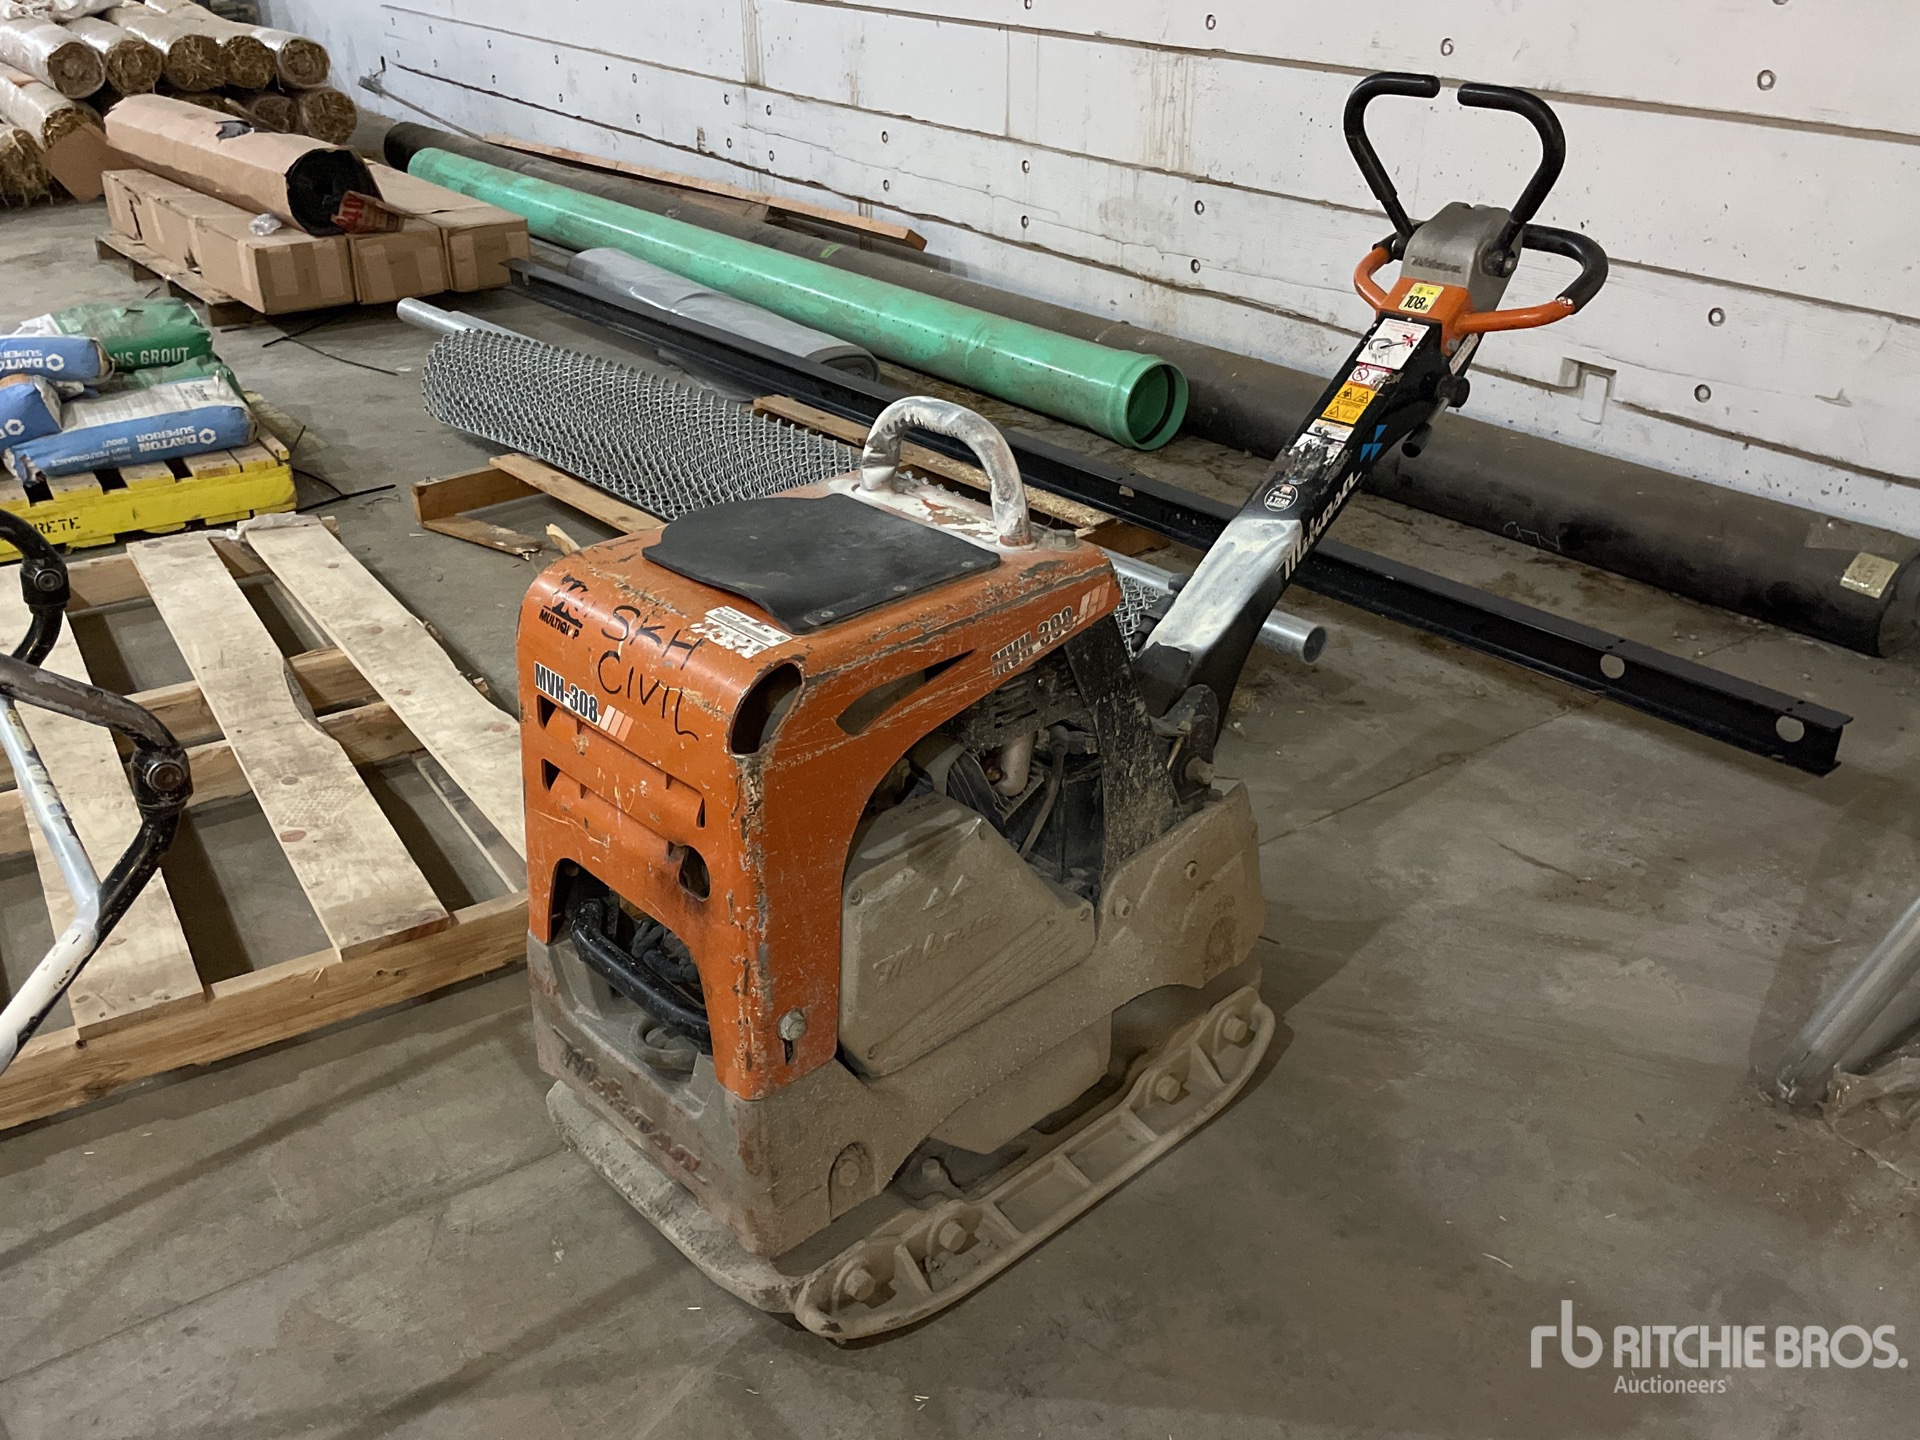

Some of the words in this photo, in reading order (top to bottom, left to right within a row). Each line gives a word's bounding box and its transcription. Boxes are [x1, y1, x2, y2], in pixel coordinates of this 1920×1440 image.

[1404, 295, 1426, 310] 108
[0, 349, 43, 359] SUPER
[140, 347, 189, 366] GROUT
[136, 425, 195, 442] SUPERIOR
[102, 437, 128, 448] GROUT
[138, 434, 198, 452] DAYTON
[535, 662, 600, 726] MVH-308
[597, 650, 699, 742] CIVIL
